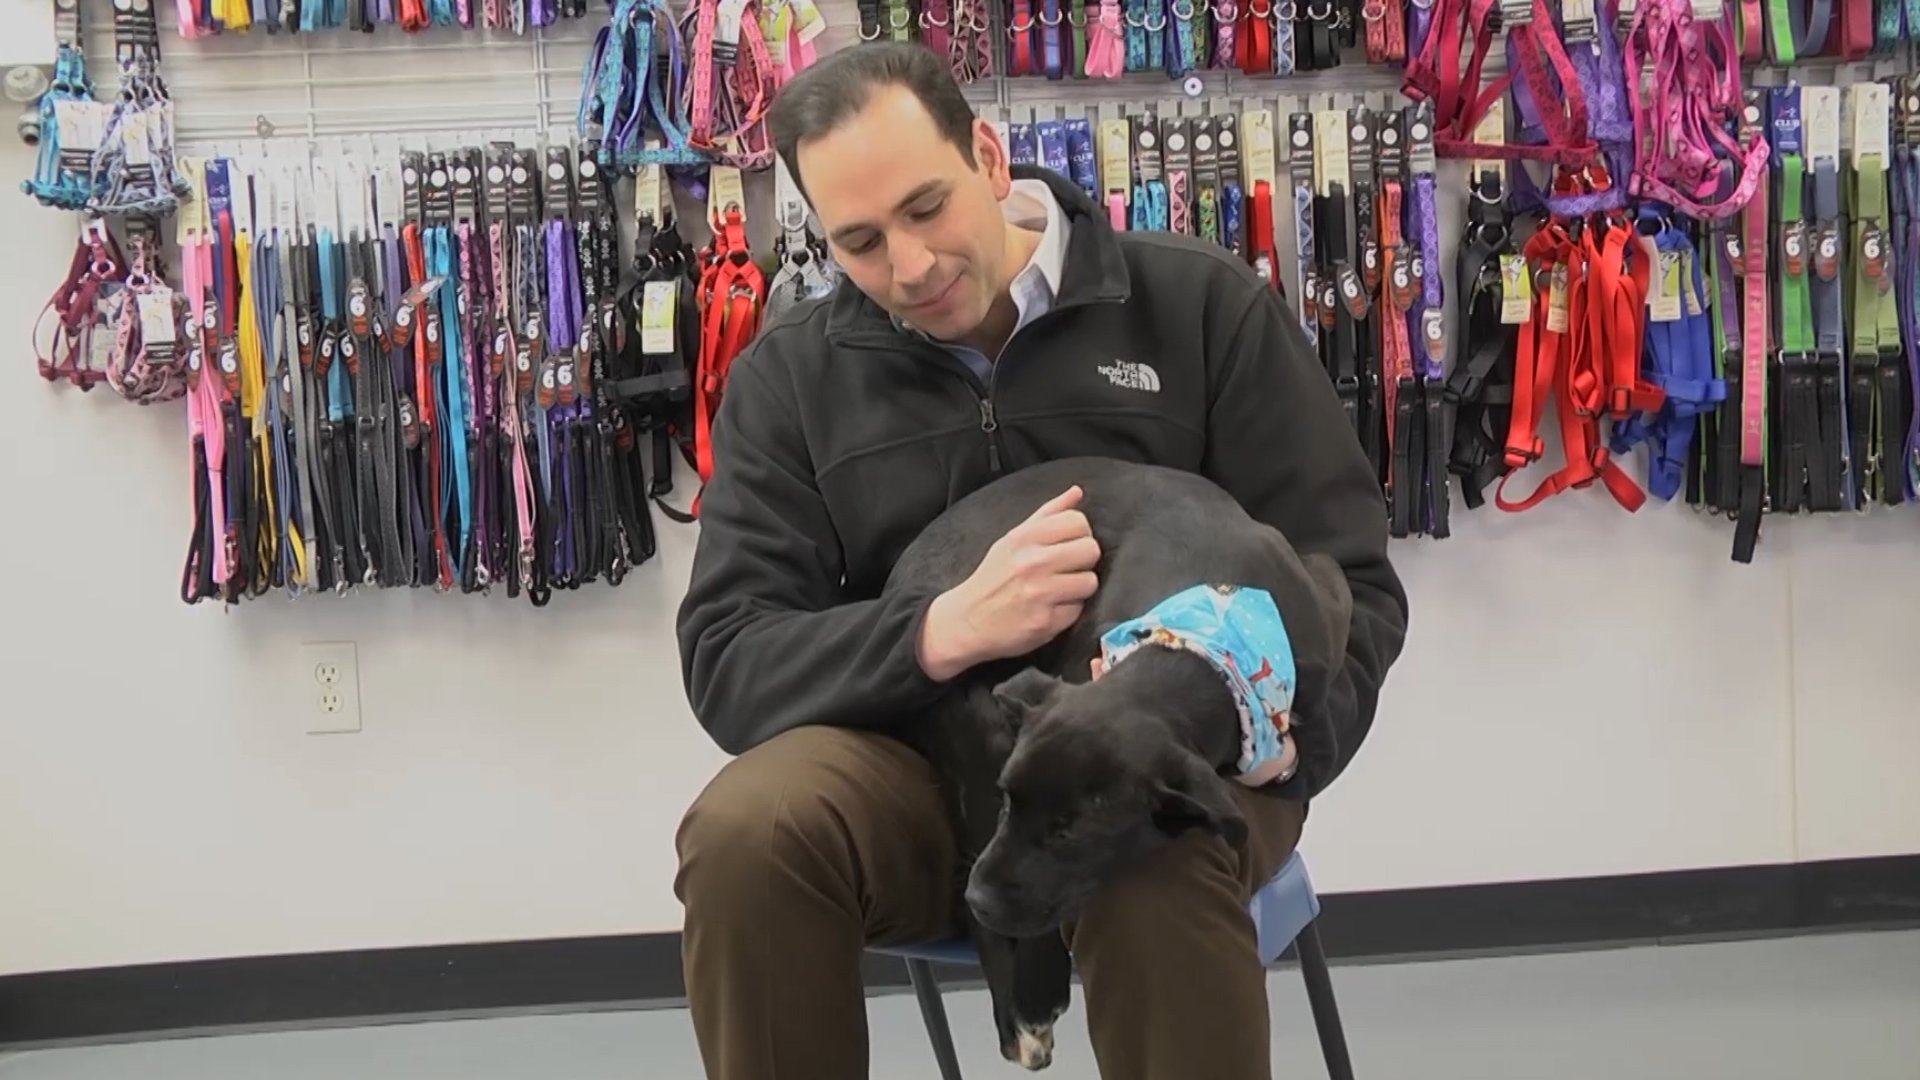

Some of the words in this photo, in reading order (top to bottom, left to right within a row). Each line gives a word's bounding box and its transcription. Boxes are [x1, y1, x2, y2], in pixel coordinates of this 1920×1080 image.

[1786, 235, 1800, 256] 6
[1820, 236, 1837, 257] 6
[1864, 237, 1880, 258] 6
[1365, 248, 1376, 268] 6
[1411, 258, 1423, 277] 6
[1343, 275, 1358, 298] 6
[1394, 265, 1408, 287] 6
[1306, 278, 1316, 299] 6
[1324, 287, 1335, 307] 6
[350, 293, 366, 316] 6
[204, 305, 217, 329] 6
[396, 306, 414, 326] 6
[299, 323, 310, 346] 6
[427, 321, 439, 342] 6
[527, 317, 540, 340] 6
[1427, 318, 1442, 340] 6
[322, 338, 335, 357] 6
[341, 335, 354, 357] 6
[222, 350, 237, 373] 6
[518, 350, 531, 371] 6
[1114, 358, 1138, 371] THE
[557, 364, 573, 385] 6
[1097, 365, 1138, 381] NORTH
[1109, 374, 1138, 388] FACE
